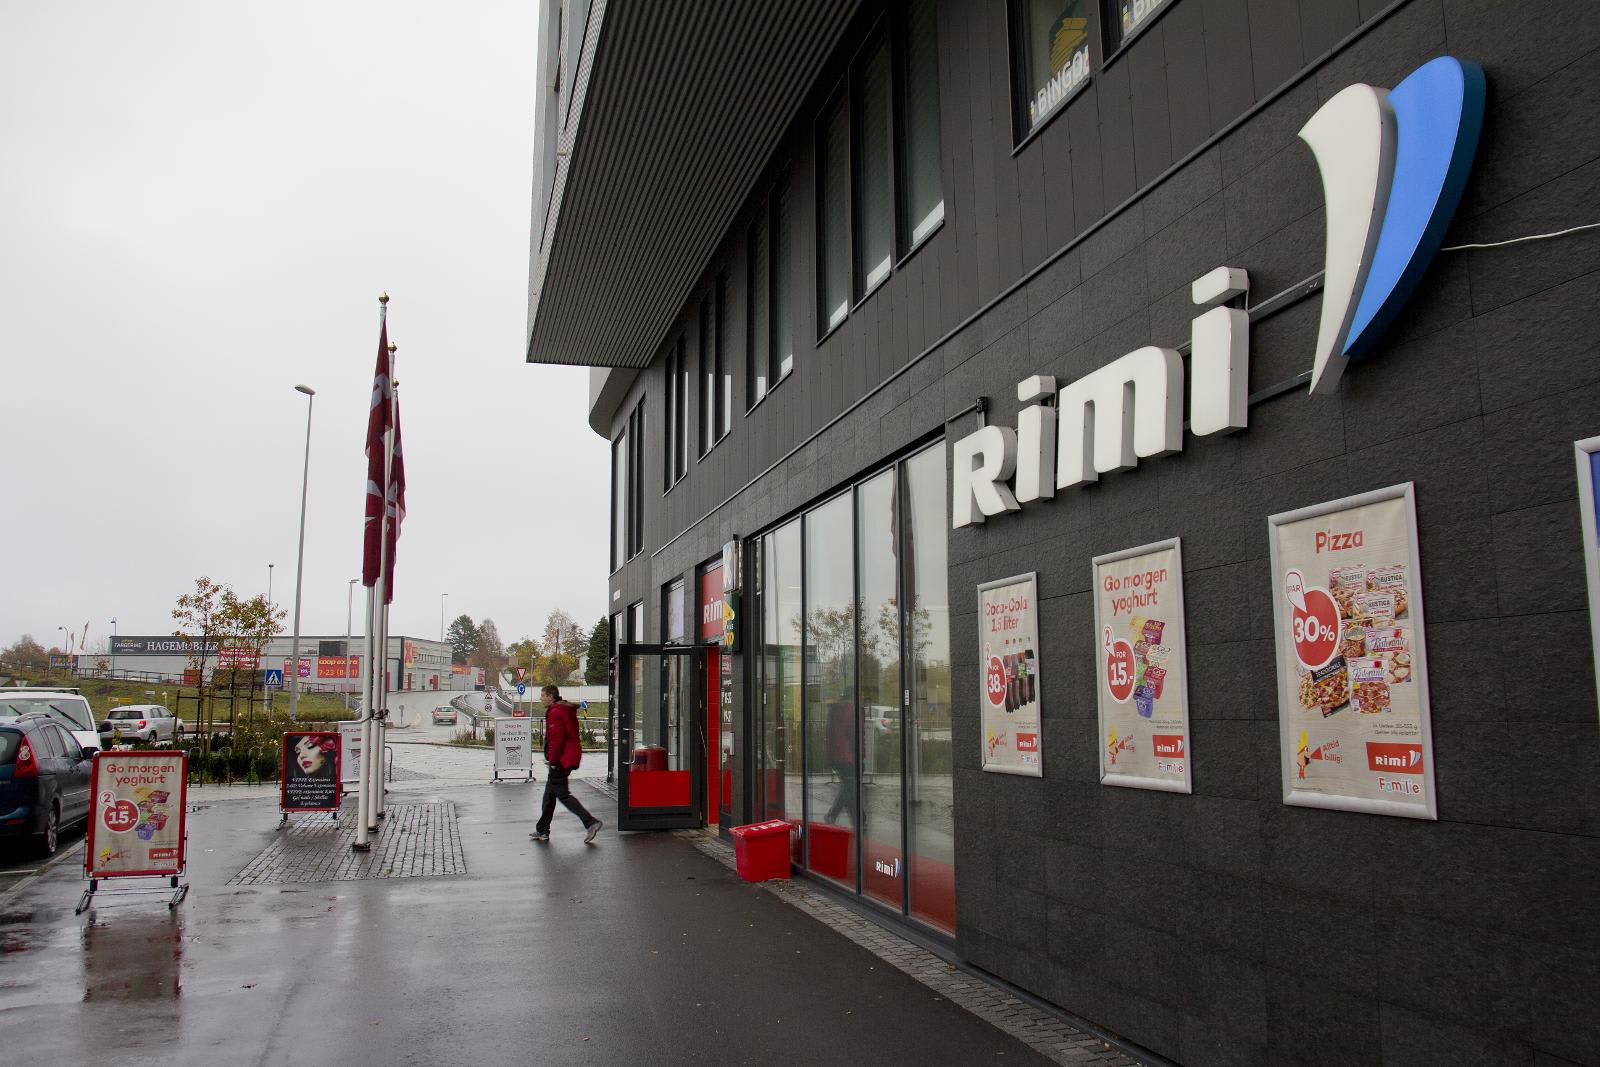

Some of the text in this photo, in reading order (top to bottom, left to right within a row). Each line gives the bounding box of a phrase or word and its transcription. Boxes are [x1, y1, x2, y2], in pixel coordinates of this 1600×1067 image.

[953, 266, 1249, 529] Rimi
[1315, 529, 1364, 554] Pizza
[1103, 568, 1168, 592] Go morgen
[985, 596, 1028, 617] Coca-Cola
[1111, 587, 1158, 617] yoghurt
[703, 597, 723, 625] Rim
[1003, 617, 1020, 631] liter
[1294, 615, 1336, 643] 30%
[1104, 629, 1112, 647] 2
[1116, 651, 1128, 659] FOR
[106, 764, 175, 775] Go morgen
[1375, 755, 1408, 767] Rimi
[115, 774, 167, 787] yoghurt
[1379, 777, 1420, 794] Familie
[103, 793, 111, 803] 2
[108, 811, 137, 824] 15,-
[875, 860, 894, 877] Rimi
